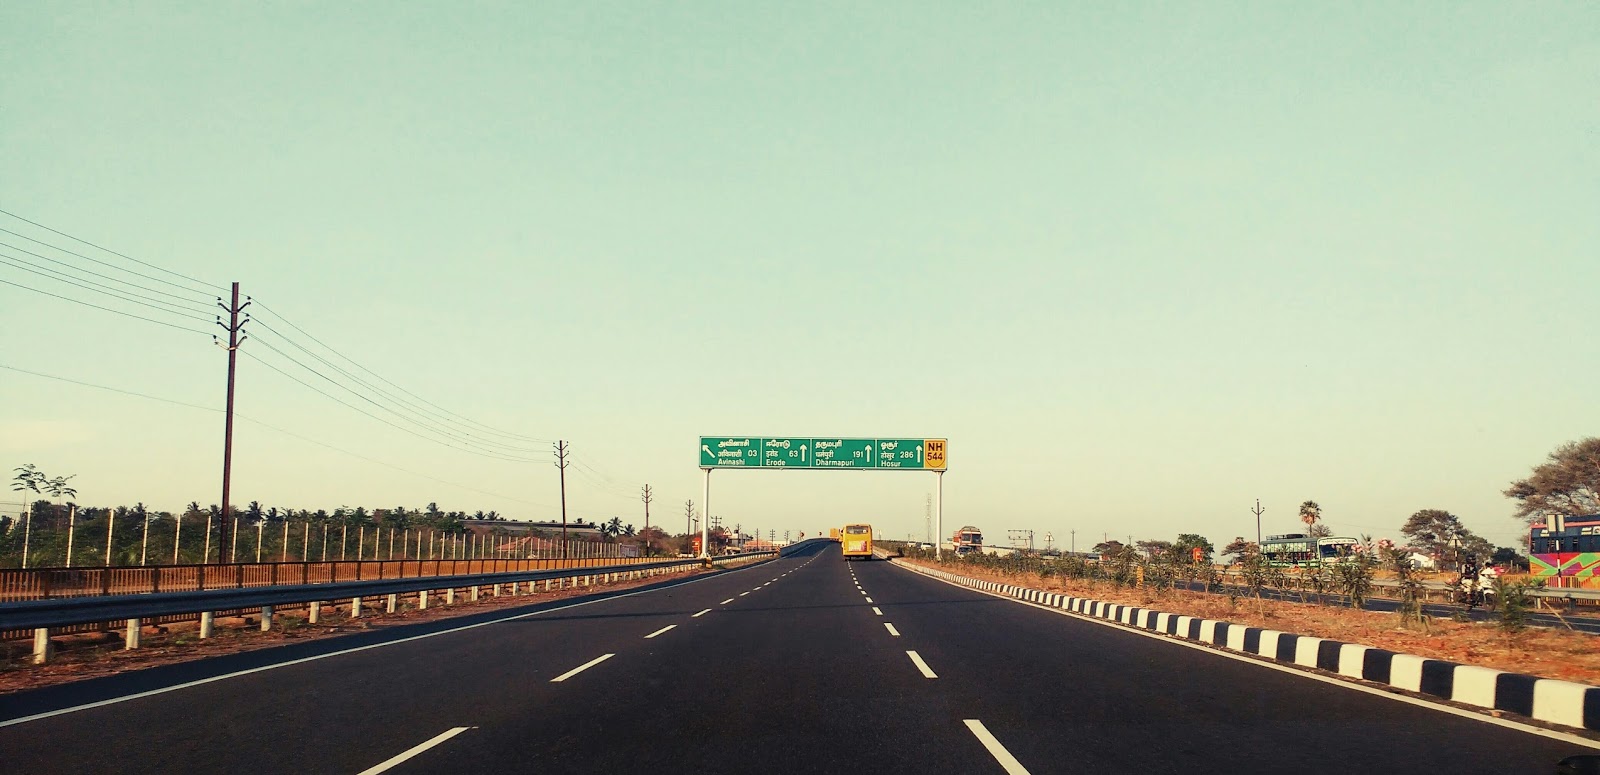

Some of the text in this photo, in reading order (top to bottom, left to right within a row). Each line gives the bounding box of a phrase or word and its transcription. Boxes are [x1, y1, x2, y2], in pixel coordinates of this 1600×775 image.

[928, 442, 943, 451] NH
[927, 452, 943, 461] 544
[815, 458, 854, 467] Dharmapuri
